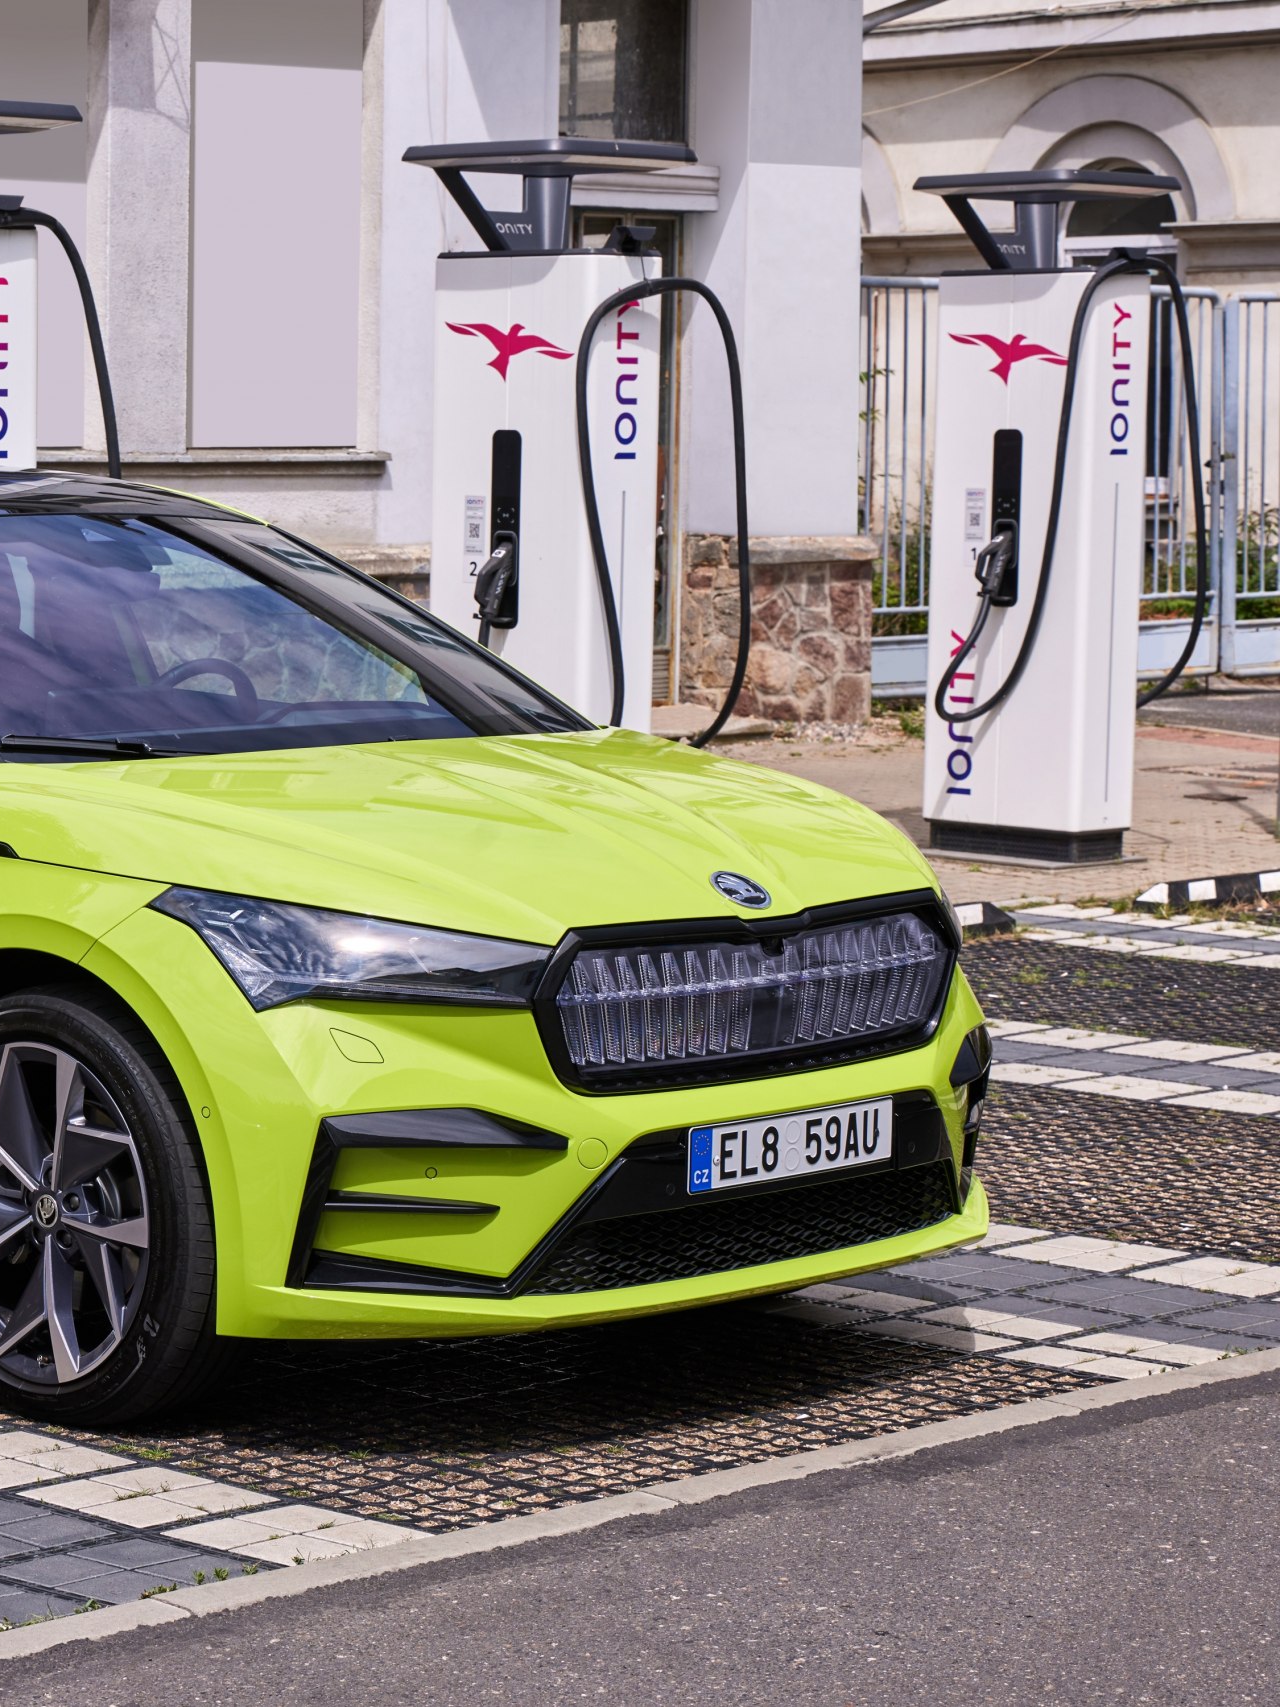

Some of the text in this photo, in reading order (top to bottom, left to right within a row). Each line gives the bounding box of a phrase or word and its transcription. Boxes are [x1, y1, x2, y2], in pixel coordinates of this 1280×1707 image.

[495, 222, 533, 234] ONITY
[996, 244, 1026, 255] NITY
[1110, 302, 1132, 456] IONITY
[971, 547, 977, 560] 1
[469, 561, 478, 577] 2
[719, 1108, 880, 1180] EL8 59AU
[693, 1168, 709, 1185] CZ
